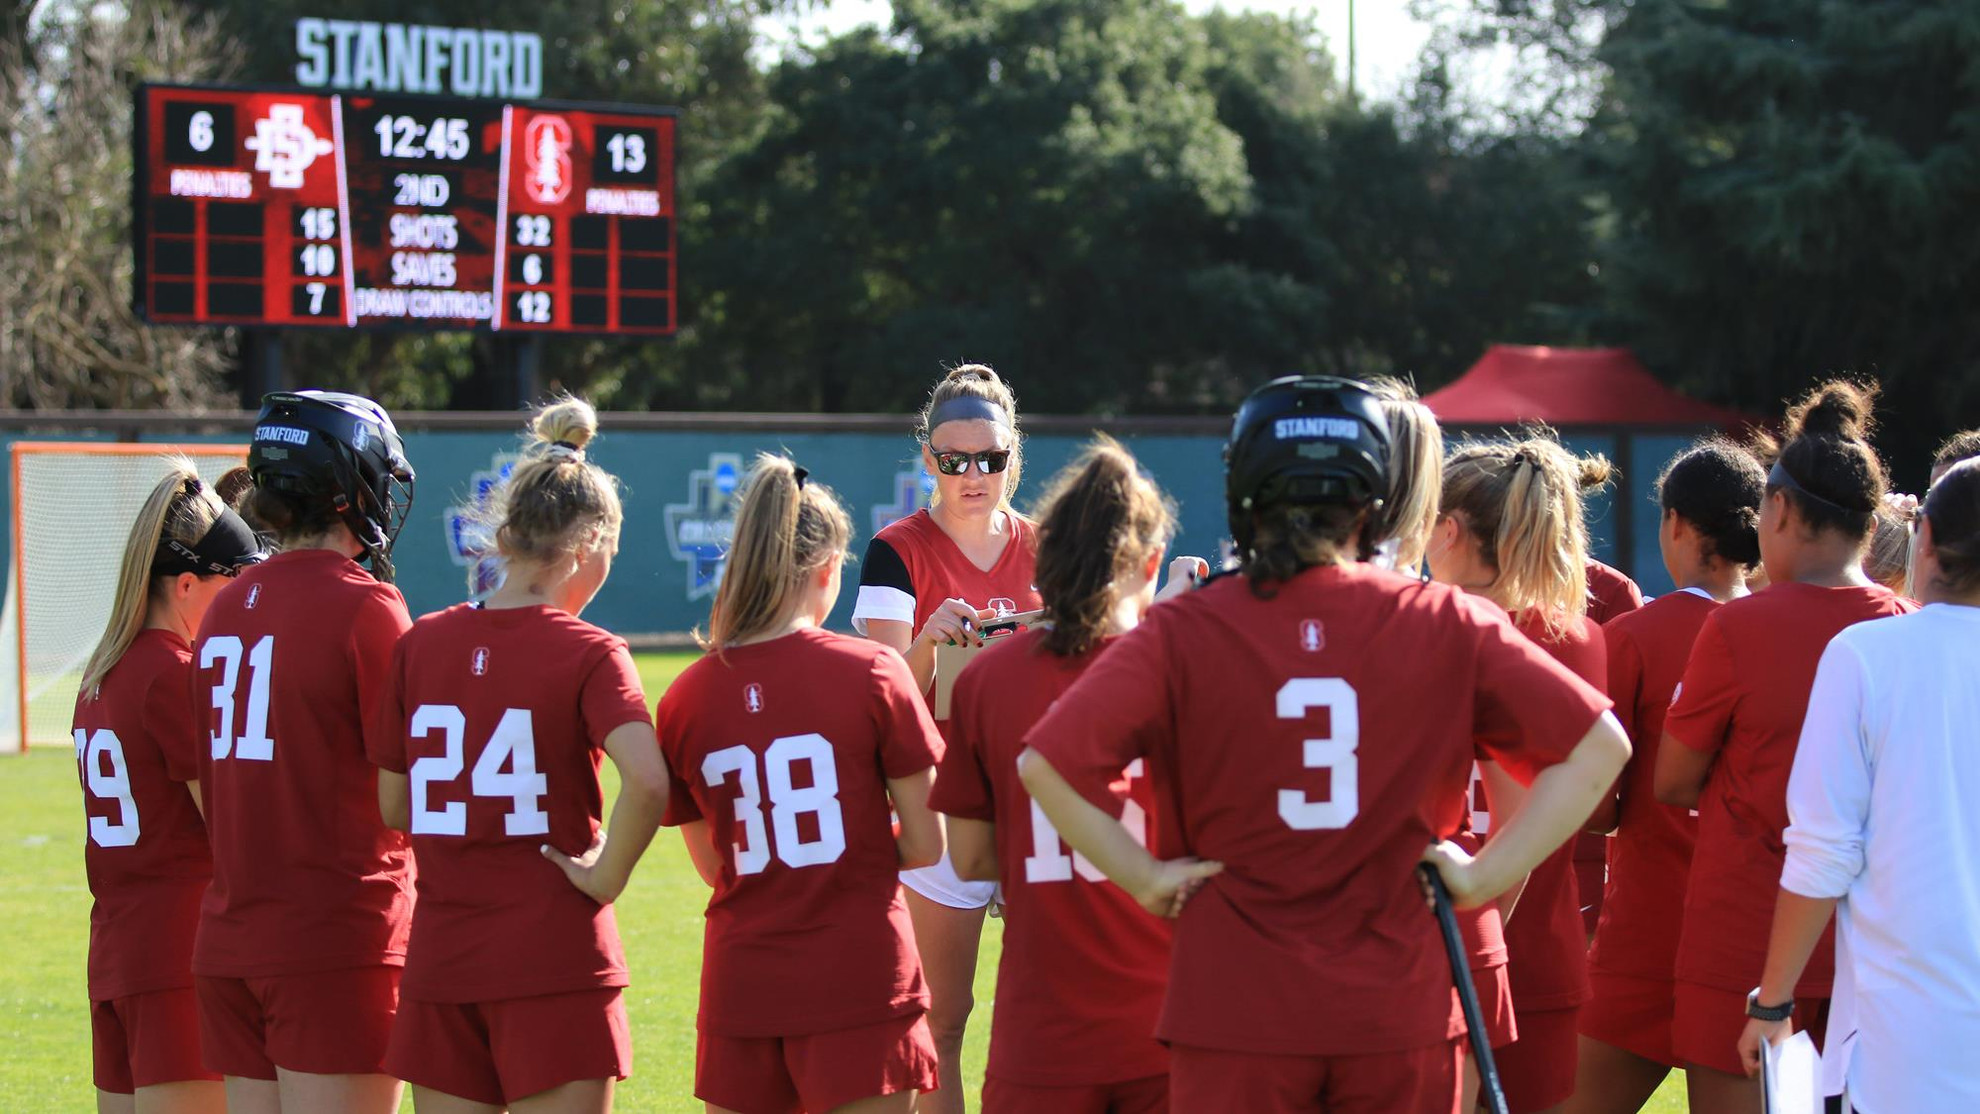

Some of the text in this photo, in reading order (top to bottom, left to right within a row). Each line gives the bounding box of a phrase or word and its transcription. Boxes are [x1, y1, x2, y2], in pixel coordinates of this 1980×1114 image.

[296, 17, 542, 98] STANFORD
[189, 110, 214, 152] 6
[374, 114, 470, 160] 12:45
[607, 133, 647, 173] 13
[394, 174, 450, 207] 2ND
[301, 207, 334, 241] 15
[389, 213, 459, 249] SHOTS
[516, 214, 551, 247] 32
[301, 244, 334, 277] 10
[391, 251, 457, 287] SAVES
[522, 253, 543, 286] 6
[305, 282, 326, 315] 7
[355, 287, 494, 320] DRAW CONTROLS
[517, 290, 551, 323] 12
[254, 425, 310, 446] STANFORD
[1275, 417, 1359, 440] STANFORD
[169, 541, 201, 563] STX
[208, 562, 235, 576] ST
[200, 635, 274, 760] 31
[410, 704, 549, 836] 24
[1276, 677, 1359, 830] 3
[701, 733, 846, 876] 38
